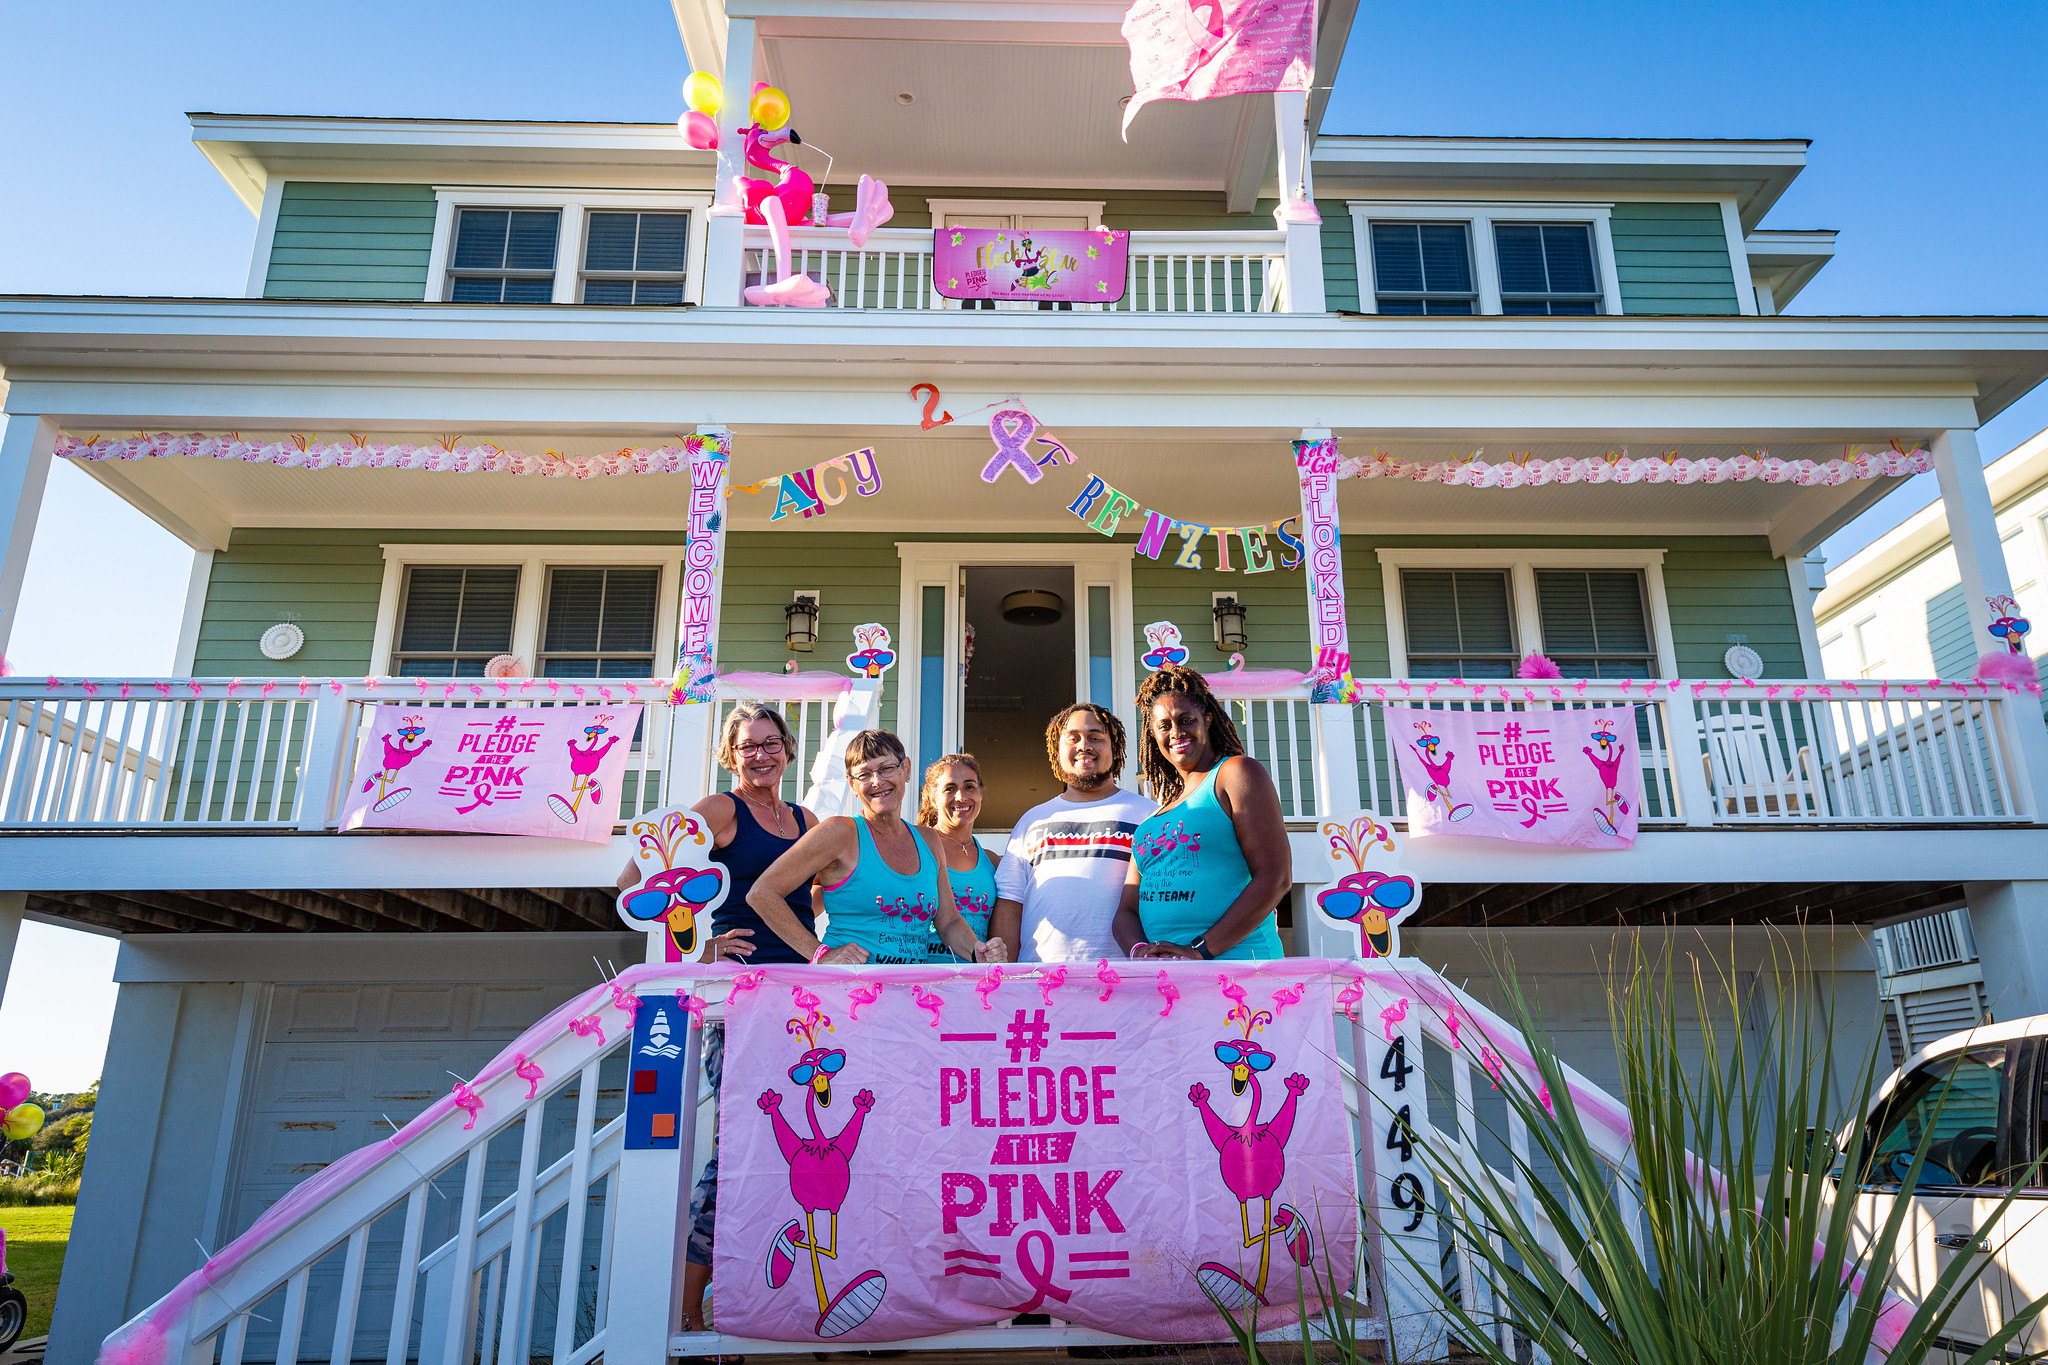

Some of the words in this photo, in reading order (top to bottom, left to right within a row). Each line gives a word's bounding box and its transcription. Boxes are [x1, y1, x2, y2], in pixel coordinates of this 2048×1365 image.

[976, 239, 1024, 270] Flock
[1039, 246, 1081, 273] Star
[966, 275, 988, 286] PINK
[1298, 442, 1334, 467] Let's
[1311, 456, 1337, 474] Get
[684, 460, 723, 656] WELCOME
[1309, 474, 1344, 647] FLOCKED
[1318, 647, 1350, 680] Up
[494, 716, 517, 733] #
[1504, 722, 1522, 742] #
[458, 733, 540, 753] PLEDGE
[1478, 742, 1555, 766] PLEDGE
[484, 756, 506, 764] THE
[444, 766, 530, 786] PINK
[1510, 768, 1532, 776] THE
[1486, 777, 1564, 800] PINK
[1158, 890, 1196, 903] TEAM!
[879, 932, 902, 947] Every
[1005, 1008, 1050, 1062] #
[940, 1064, 1119, 1128] PLEDGE
[1378, 1034, 1427, 1233] 449
[1008, 1137, 1059, 1163] THE
[942, 1170, 1126, 1238] PINK
